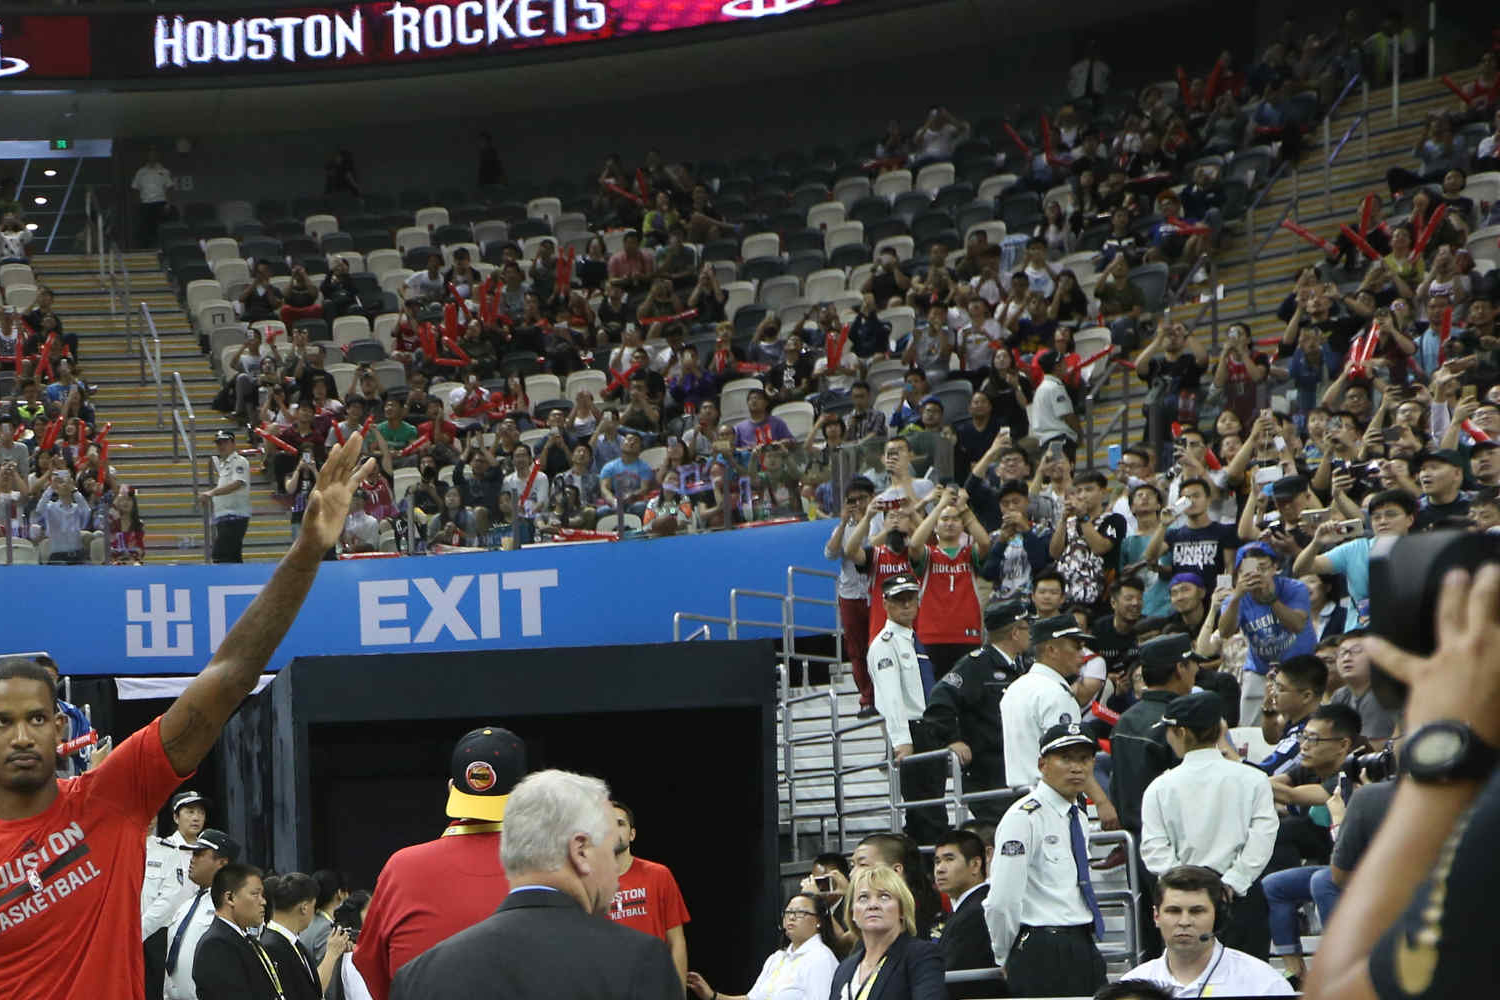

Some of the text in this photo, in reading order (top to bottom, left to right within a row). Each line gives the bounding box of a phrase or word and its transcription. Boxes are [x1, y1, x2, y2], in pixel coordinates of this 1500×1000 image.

[154, 0, 606, 68] HOUSTON ROCKETS
[1173, 543, 1218, 557] LINKIN
[1173, 555, 1216, 570] PARK
[948, 575, 956, 593] 1
[359, 569, 558, 646] EXIT
